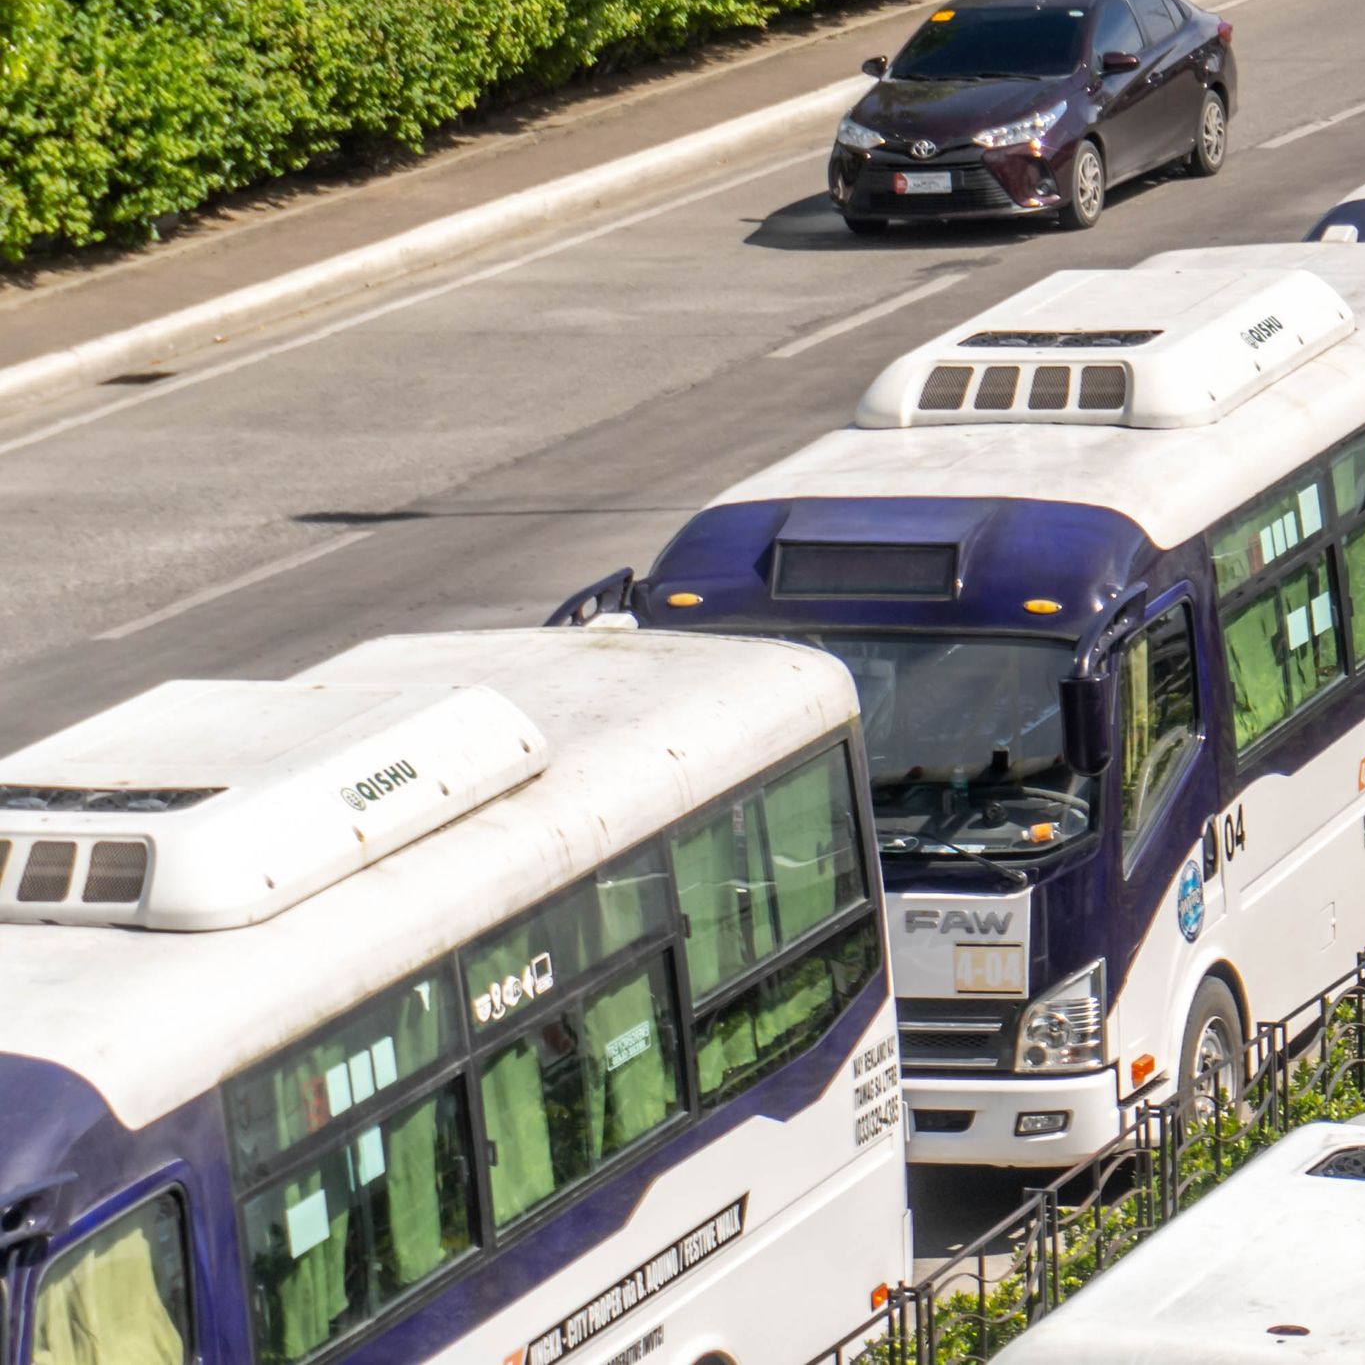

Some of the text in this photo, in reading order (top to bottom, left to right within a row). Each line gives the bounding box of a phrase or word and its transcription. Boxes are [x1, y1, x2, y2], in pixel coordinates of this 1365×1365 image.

[1248, 315, 1284, 343] QISHU
[356, 759, 418, 801] QISHU
[1225, 803, 1245, 862] 04
[904, 909, 1013, 935] FAW
[957, 951, 1020, 985] 4-04
[566, 1308, 589, 1349] CITY
[587, 1286, 623, 1334] PROPER
[622, 1279, 638, 1310] via
[646, 1247, 679, 1295] AQUINO
[684, 1221, 717, 1267] FESTIVE
[715, 1203, 741, 1247] WALK
